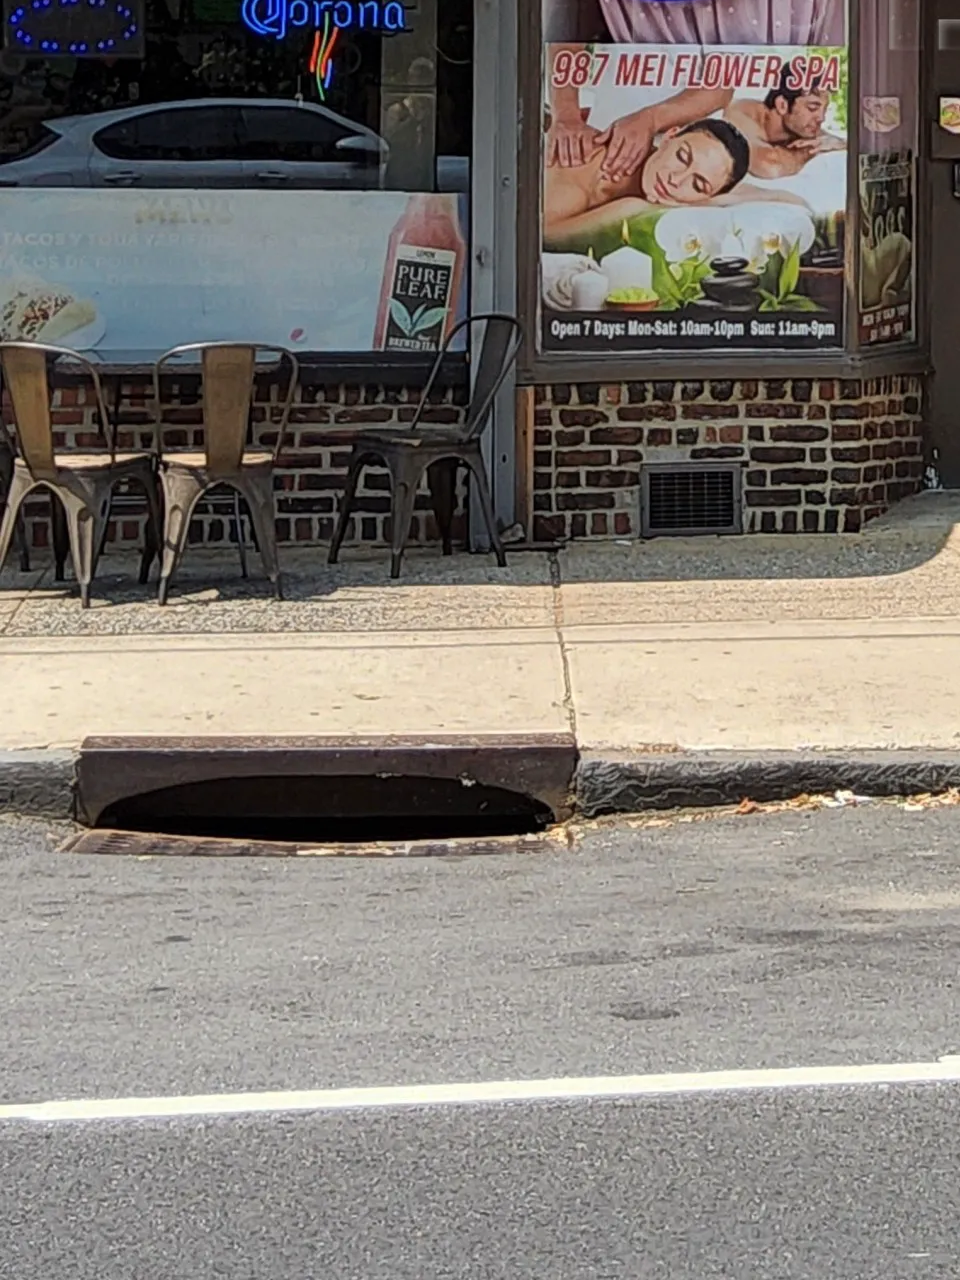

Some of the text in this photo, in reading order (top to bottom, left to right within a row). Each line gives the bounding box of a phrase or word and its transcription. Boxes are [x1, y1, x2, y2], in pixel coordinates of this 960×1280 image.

[552, 51, 840, 90] 987 MEI FLOWER SPA
[398, 265, 448, 285] PURE
[551, 320, 835, 339] Open 7 Days: Mon-Sat: 10am-10pm Sun: 11am-9pm
